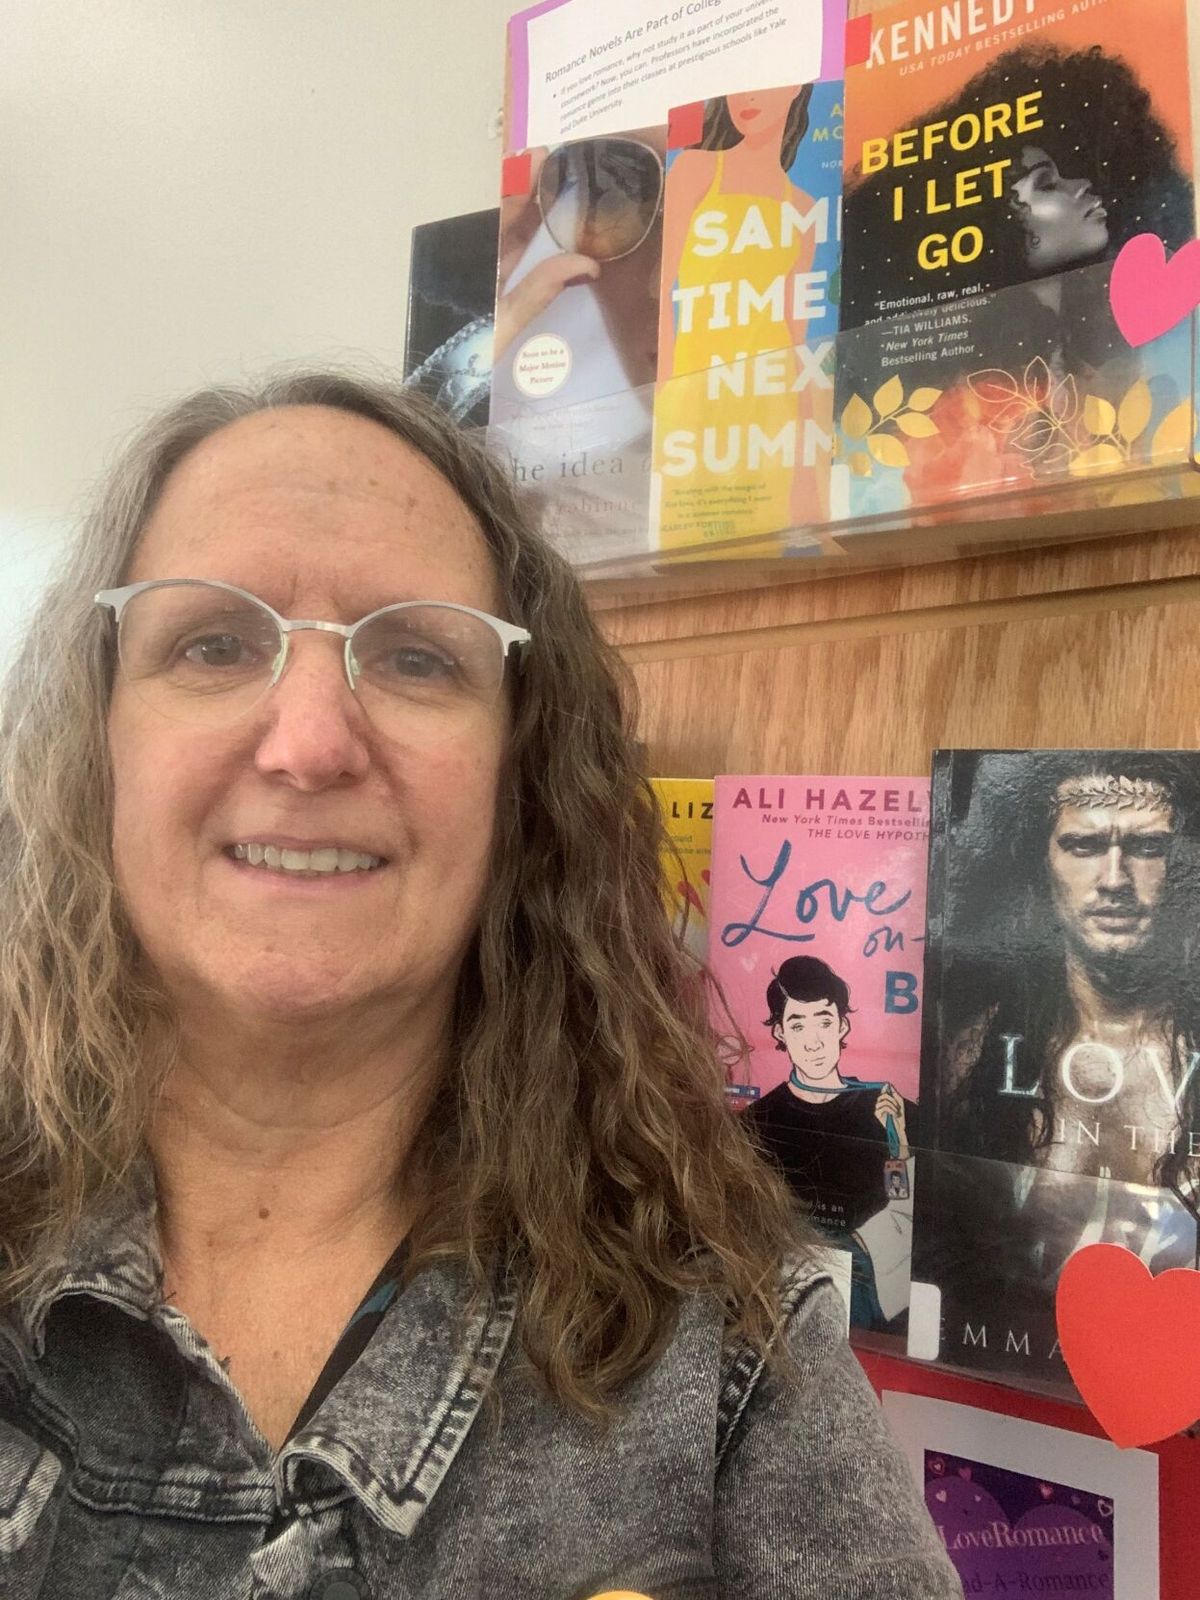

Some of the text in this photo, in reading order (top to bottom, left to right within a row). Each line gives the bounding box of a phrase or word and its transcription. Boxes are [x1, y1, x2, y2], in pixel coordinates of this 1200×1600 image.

[545, 54, 587, 83] Romance
[589, 35, 622, 59] Novels
[624, 27, 644, 43] Are
[646, 15, 668, 32] Part
[671, 6, 684, 21] of
[567, 82, 578, 93] you
[578, 74, 592, 84] love
[626, 51, 641, 62] why
[643, 44, 655, 54] not
[657, 34, 677, 48] study
[680, 31, 685, 40] it
[687, 28, 696, 37] as
[697, 20, 714, 34] part
[715, 15, 724, 25] of
[725, 8, 744, 23] your
[620, 67, 633, 79] you
[651, 44, 690, 64] Professors
[692, 36, 711, 47] have
[713, 13, 764, 40] incorporated
[765, 6, 779, 18] the
[900, 61, 924, 77] USA
[930, 44, 971, 68] TODAY
[976, 10, 1065, 51] BESTSELLING
[560, 18, 787, 120] romance genre into their classes at prestigious schools like Yale
[560, 99, 622, 134] and Duke University
[861, 90, 1044, 175] BEFORE
[893, 159, 1011, 222] I LET
[692, 196, 843, 257] SAM
[917, 225, 984, 271] GO
[672, 271, 827, 333] TIME
[881, 344, 975, 367] Bestselling Author
[886, 330, 969, 352] New York Times
[519, 363, 540, 372] Major
[529, 376, 554, 385] Picture
[560, 451, 623, 478] idea
[671, 801, 714, 820] LIZ
[732, 787, 931, 812] ALI HAZEL
[761, 814, 789, 825] New
[793, 814, 821, 826] York
[826, 815, 863, 827] Times
[807, 828, 832, 839] THE
[837, 829, 871, 841] LOVE
[720, 839, 913, 948] Love
[884, 971, 919, 1015] B
[998, 1033, 1200, 1112] LOV
[1058, 1118, 1200, 1158] IN THE
[939, 1521, 1103, 1550] LoveRomance
